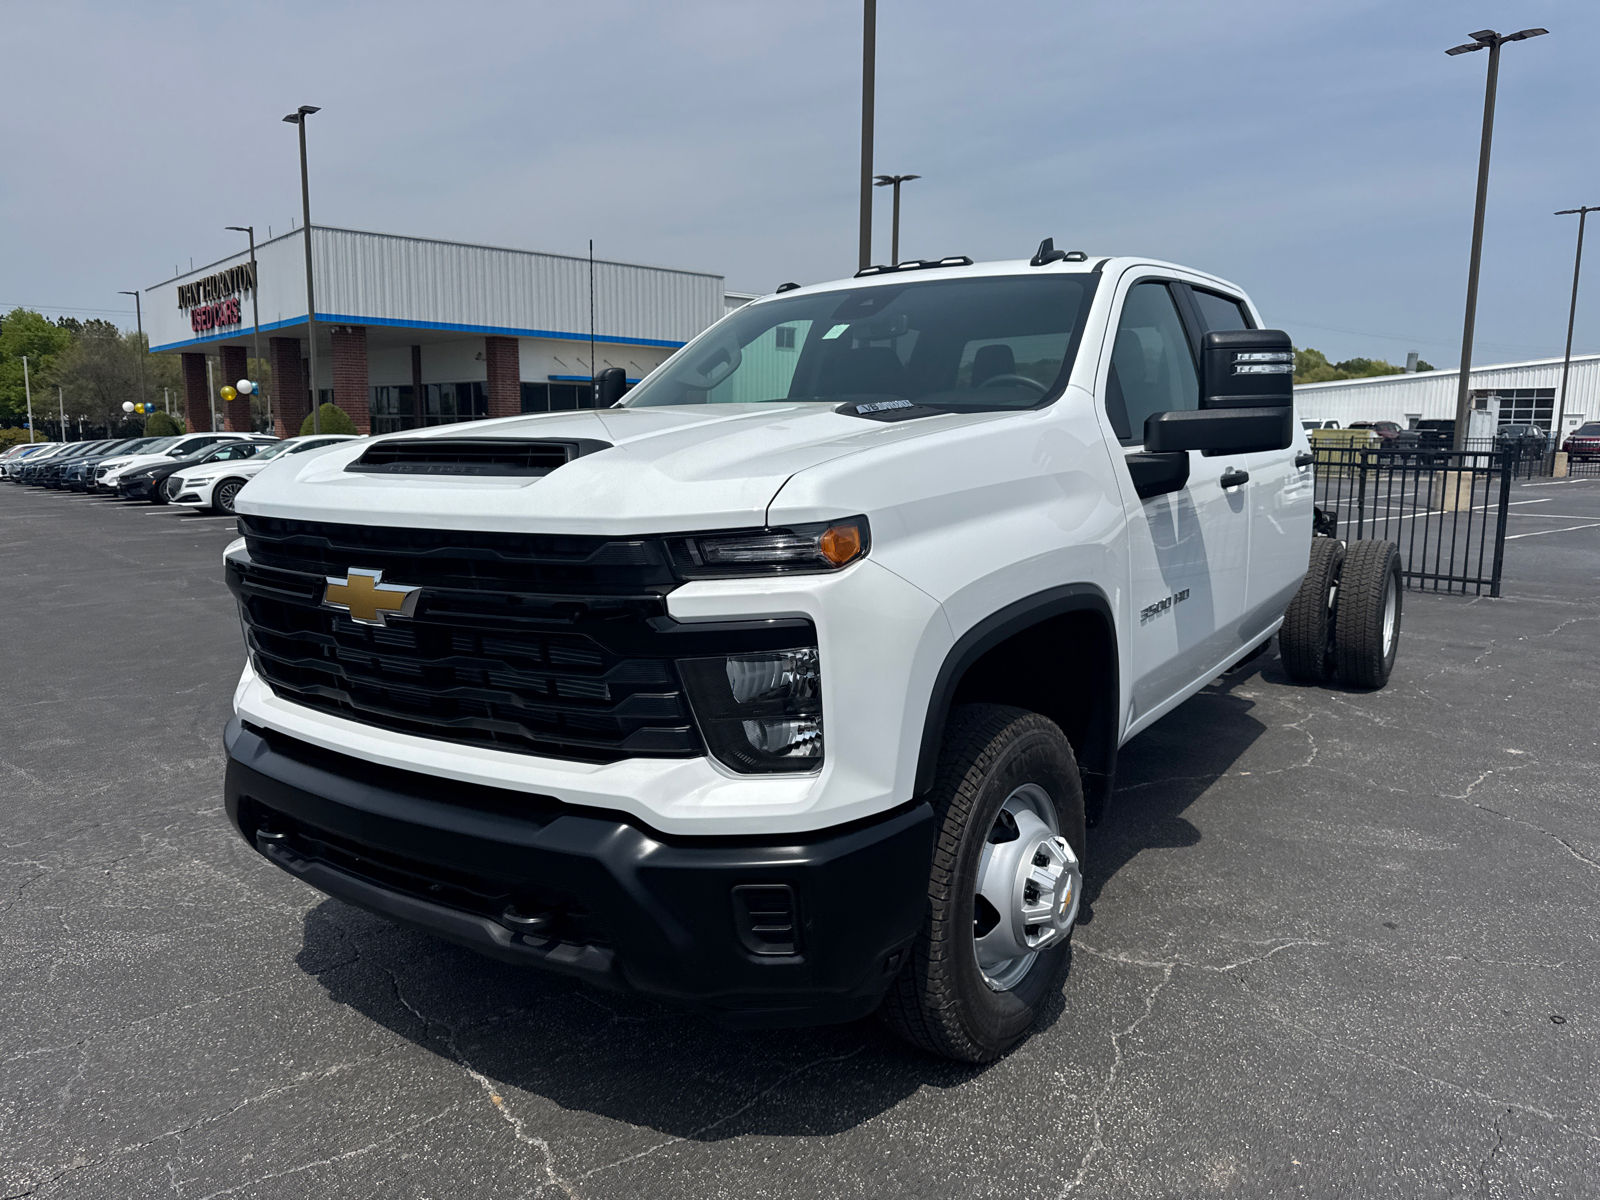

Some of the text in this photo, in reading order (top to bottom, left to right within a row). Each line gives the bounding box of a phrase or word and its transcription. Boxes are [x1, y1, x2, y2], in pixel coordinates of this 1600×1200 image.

[177, 261, 257, 309] JOHN THORNTON
[191, 297, 241, 332] USED CARS
[1140, 588, 1190, 622] 3500 HD
